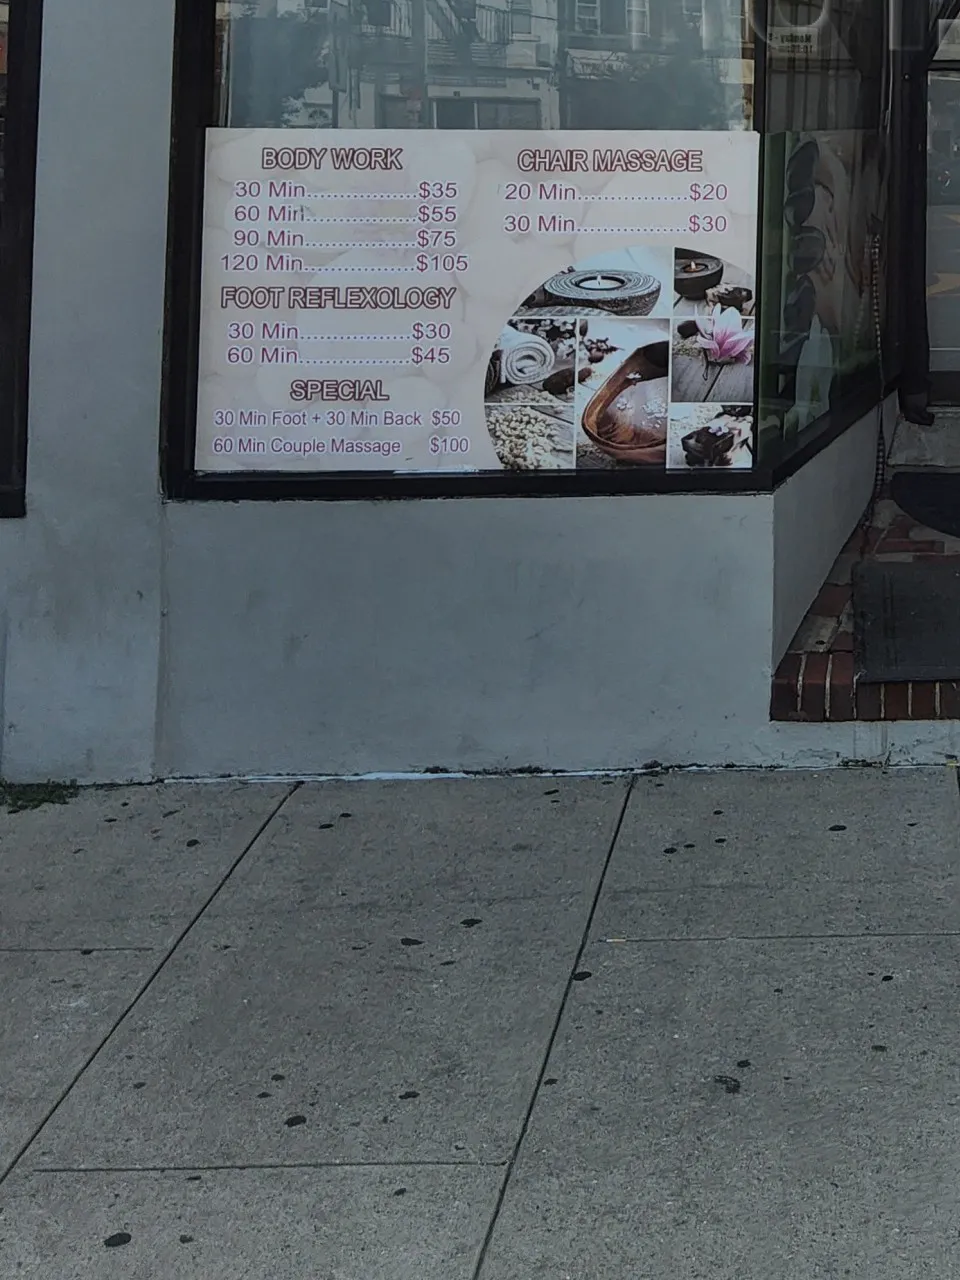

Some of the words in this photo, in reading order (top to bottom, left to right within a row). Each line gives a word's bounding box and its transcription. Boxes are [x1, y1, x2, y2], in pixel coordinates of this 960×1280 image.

[262, 148, 327, 169] BODY
[331, 148, 403, 169] WORK
[517, 149, 589, 172] CHAIR
[593, 149, 703, 172] MASSAGE
[235, 181, 260, 197] 30
[419, 181, 458, 199] $35
[504, 183, 531, 200] 20
[689, 183, 728, 202] $20
[234, 206, 260, 222] 60
[418, 205, 457, 223] $55
[504, 215, 530, 232] 30
[688, 214, 727, 233] $30
[233, 230, 259, 246] 90
[417, 230, 456, 248] $75
[221, 254, 258, 271] 120
[416, 254, 468, 272] $105
[221, 286, 284, 309] FOOT
[289, 287, 456, 309] REFLEXOLOGY
[228, 323, 254, 339] 30
[412, 322, 451, 340] $30
[227, 347, 253, 364] 60
[411, 347, 450, 364] $45
[290, 380, 389, 401] SPECIAL
[215, 411, 234, 425] 30
[239, 411, 266, 425] Min
[272, 411, 307, 425] Foot
[326, 411, 345, 425] 30
[351, 411, 378, 425] Min
[384, 410, 422, 425] Back
[431, 410, 460, 426] $50
[214, 438, 233, 453] 60
[238, 438, 265, 453] Min
[271, 438, 325, 456] Couple
[331, 438, 401, 456] Massage
[430, 437, 469, 453] $100
